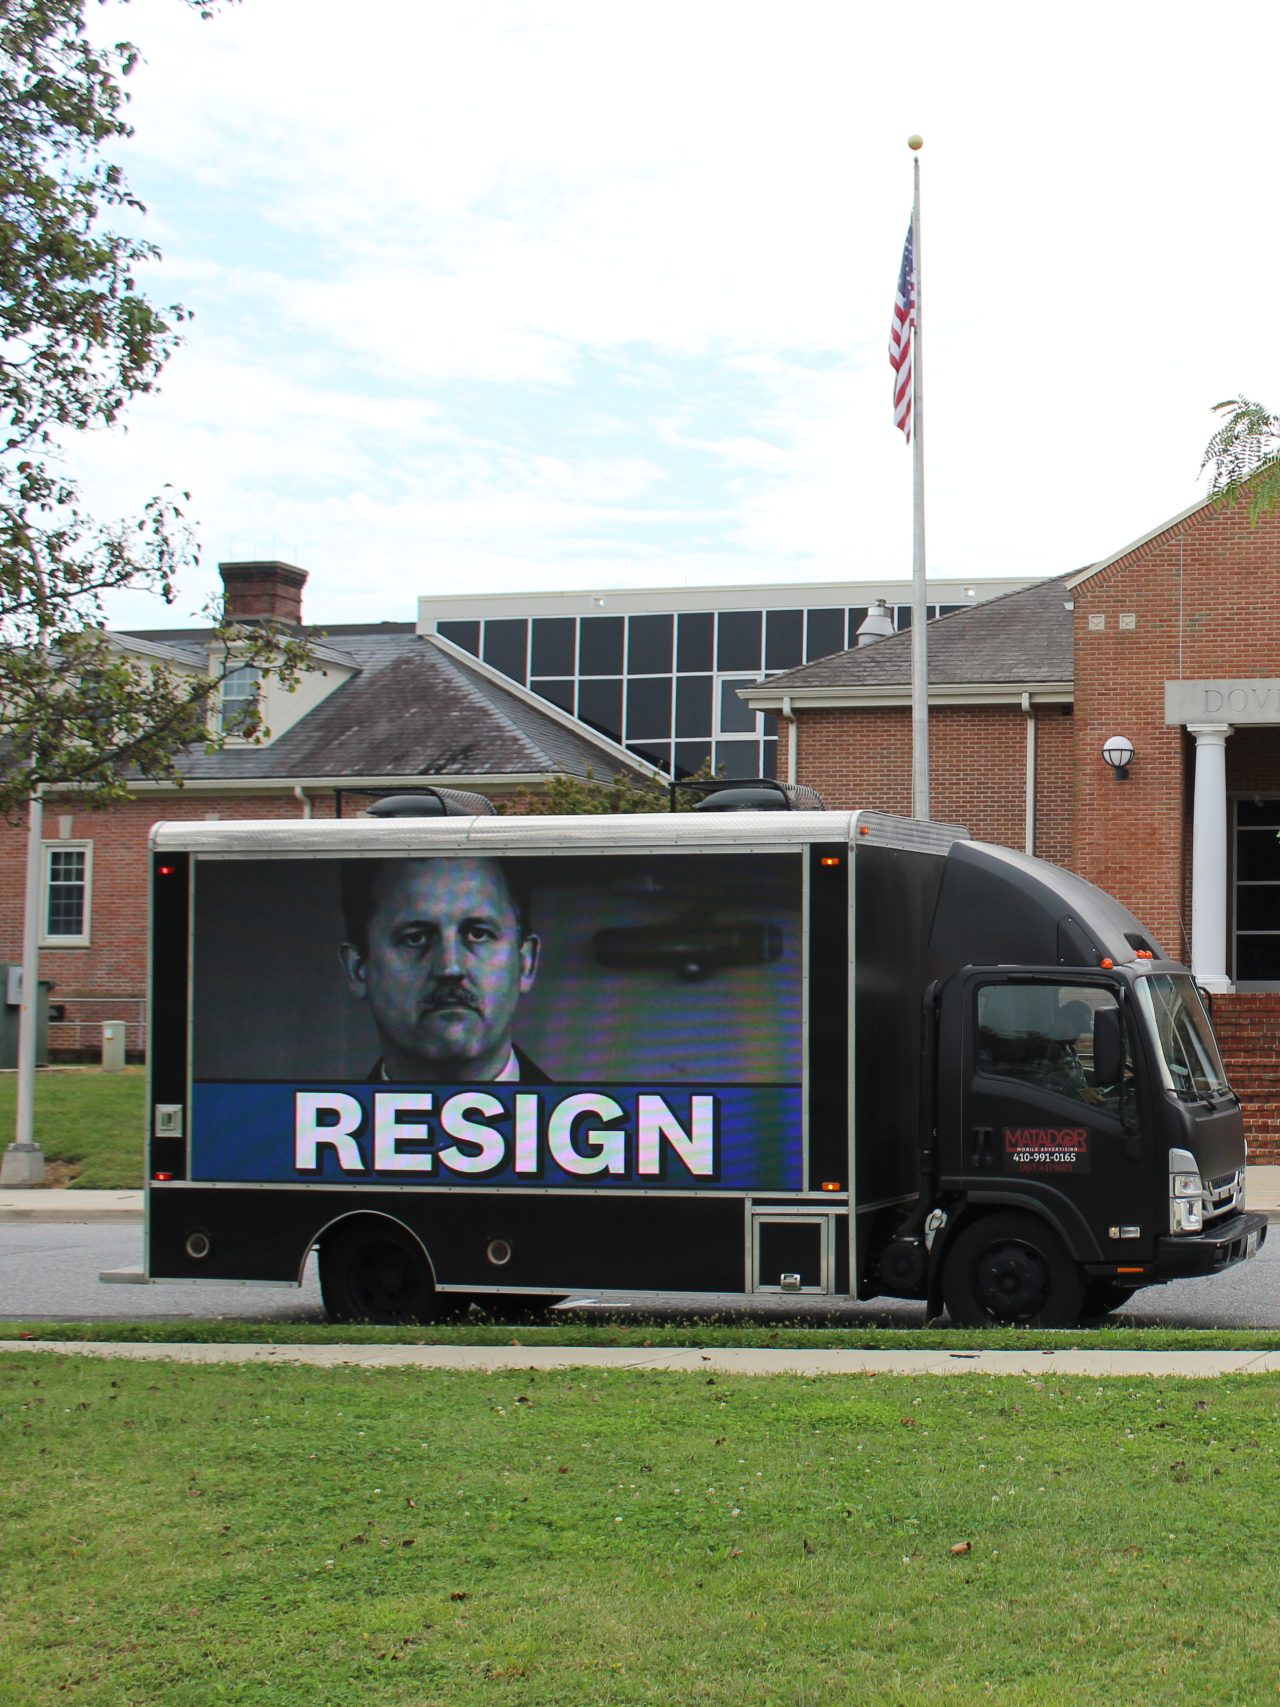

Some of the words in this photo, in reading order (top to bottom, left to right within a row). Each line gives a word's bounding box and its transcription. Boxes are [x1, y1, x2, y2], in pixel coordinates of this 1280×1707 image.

[295, 1091, 717, 1178] RESIGN
[1006, 1129, 1087, 1149] MATADOR
[1013, 1153, 1076, 1162] 410-991-0165
